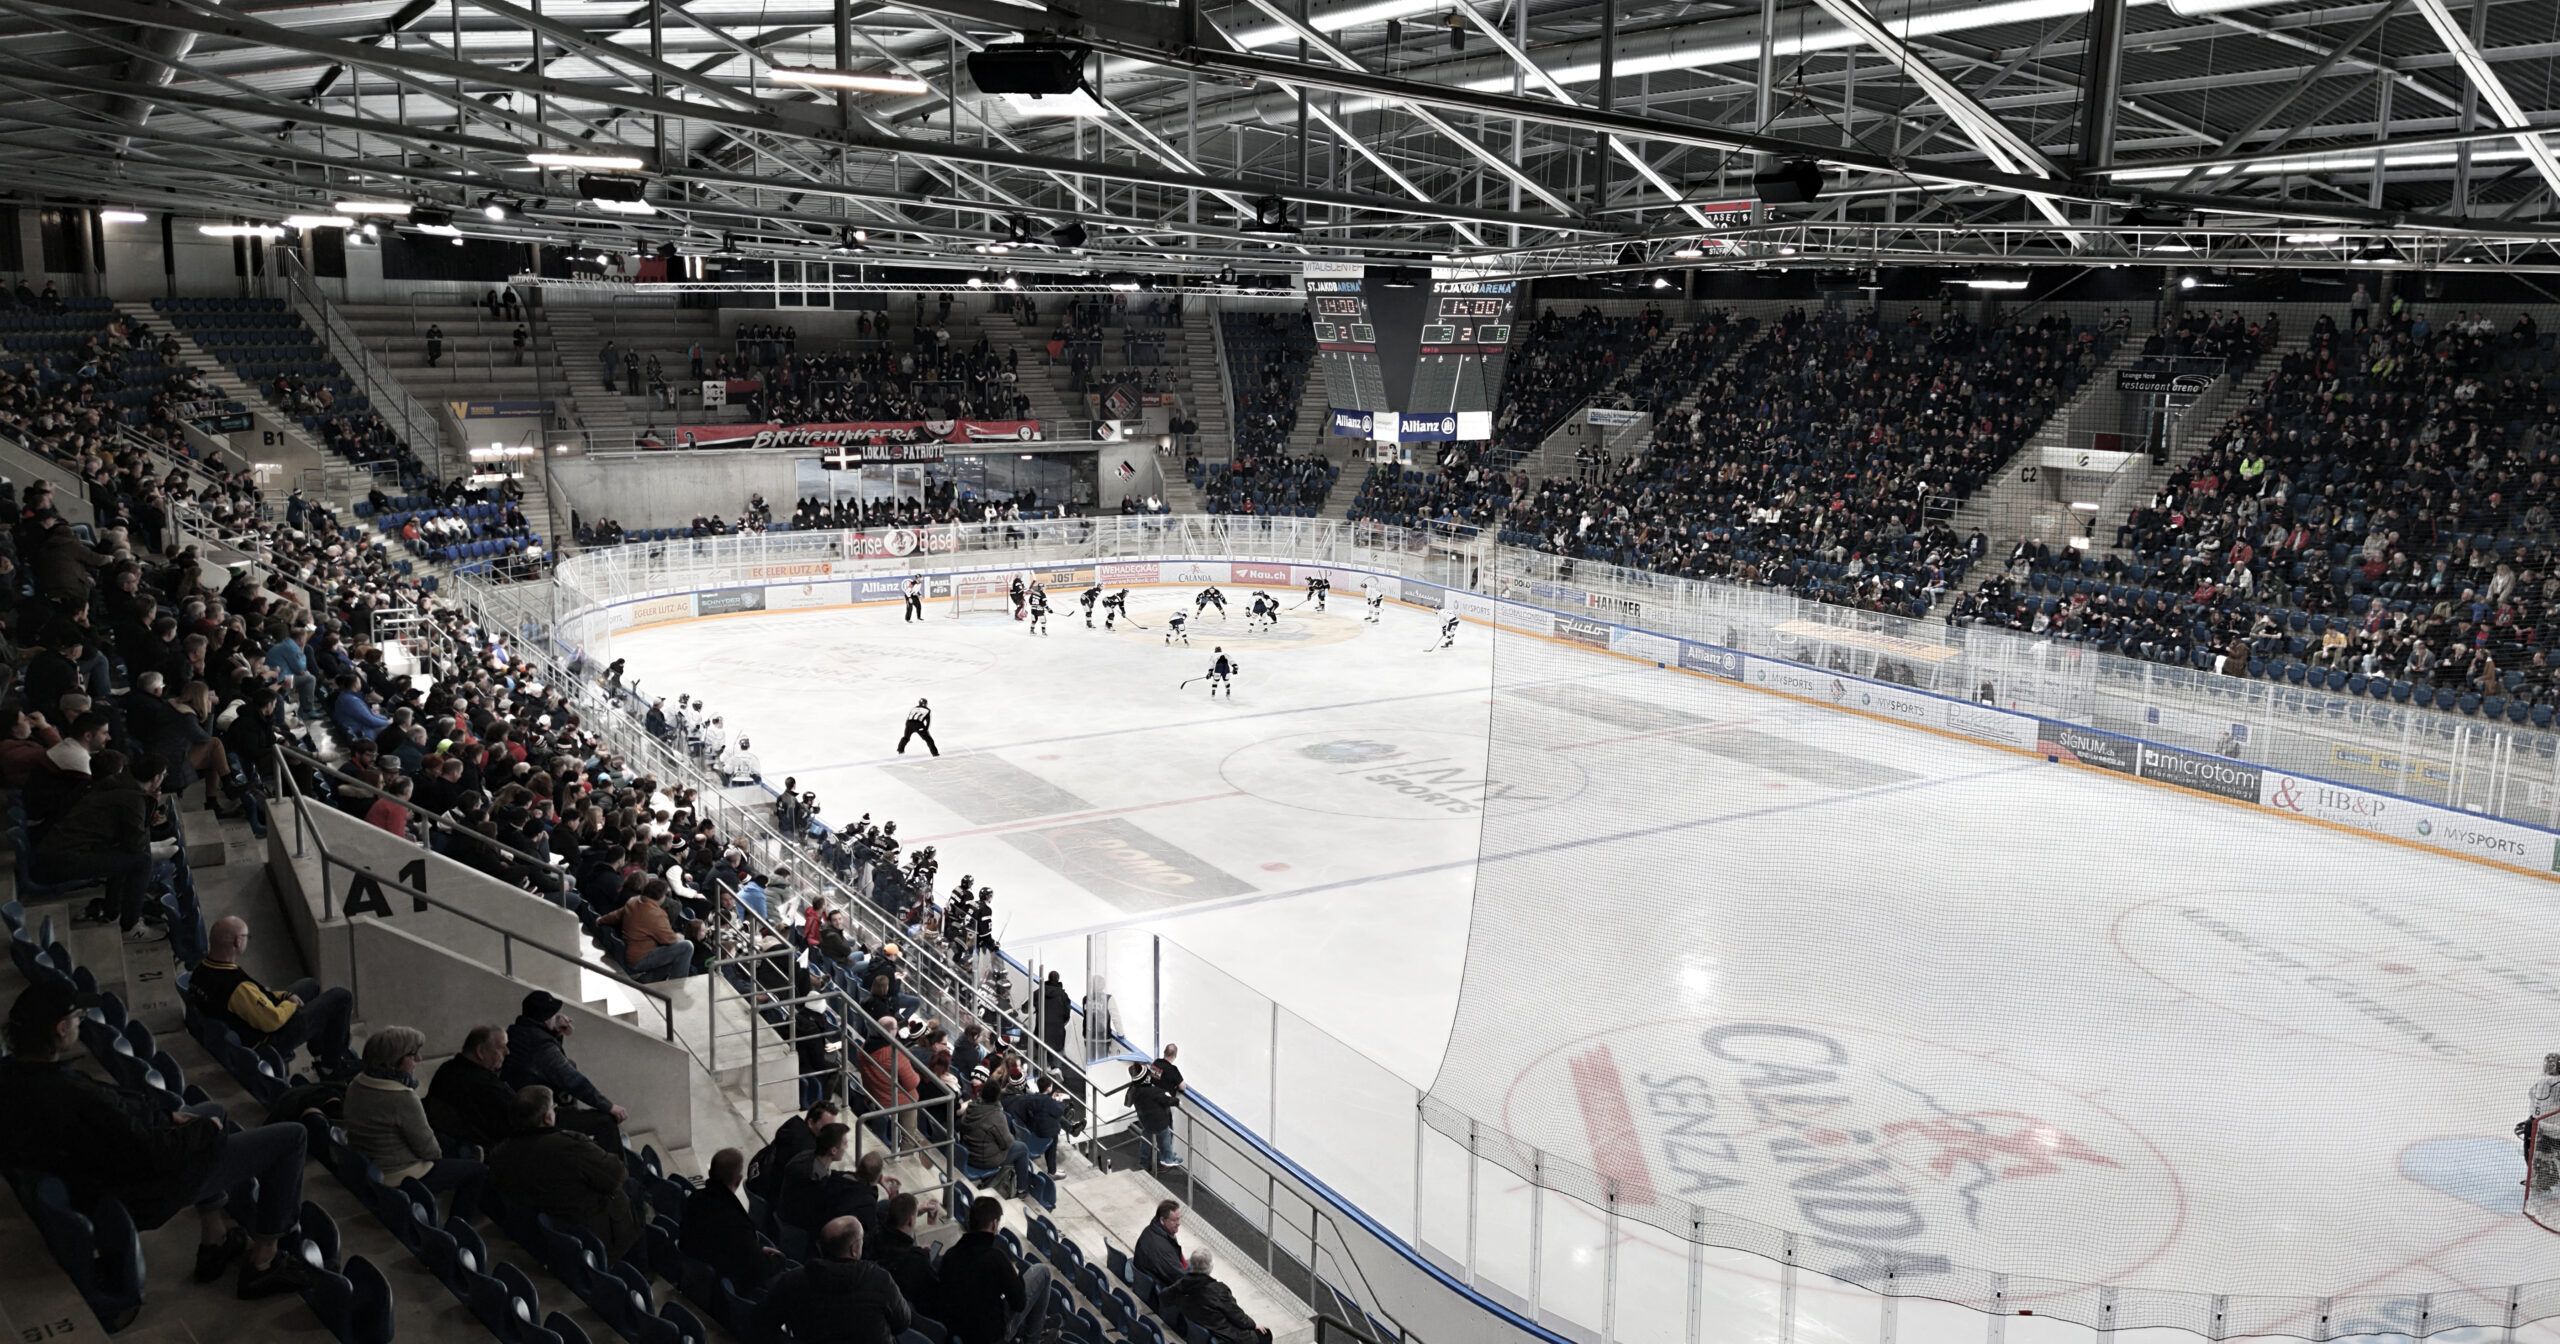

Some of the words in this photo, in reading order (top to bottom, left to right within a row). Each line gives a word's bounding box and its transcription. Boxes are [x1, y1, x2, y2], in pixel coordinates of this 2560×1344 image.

[1460, 327, 1472, 341] 2
[2121, 380, 2170, 392] restaurant
[1335, 414, 1361, 429] Allianz
[1401, 420, 1439, 433] Allianz
[263, 431, 285, 446] B1
[861, 446, 891, 460] LOKAL
[2021, 466, 2037, 482] C2
[843, 533, 882, 556] Hanse
[789, 564, 811, 575] LUTZ
[814, 563, 830, 574] AG
[1249, 568, 1287, 581] Nau.ch
[1051, 573, 1075, 584] JOST
[1178, 573, 1212, 583] CALANDA
[861, 582, 900, 593] Allianz
[634, 607, 657, 619] EGELER
[658, 604, 675, 614] LUTZ
[677, 602, 688, 611] AG
[2161, 752, 2255, 788] microtom
[2445, 827, 2525, 856] MYSPORTS
[343, 859, 428, 917] A1
